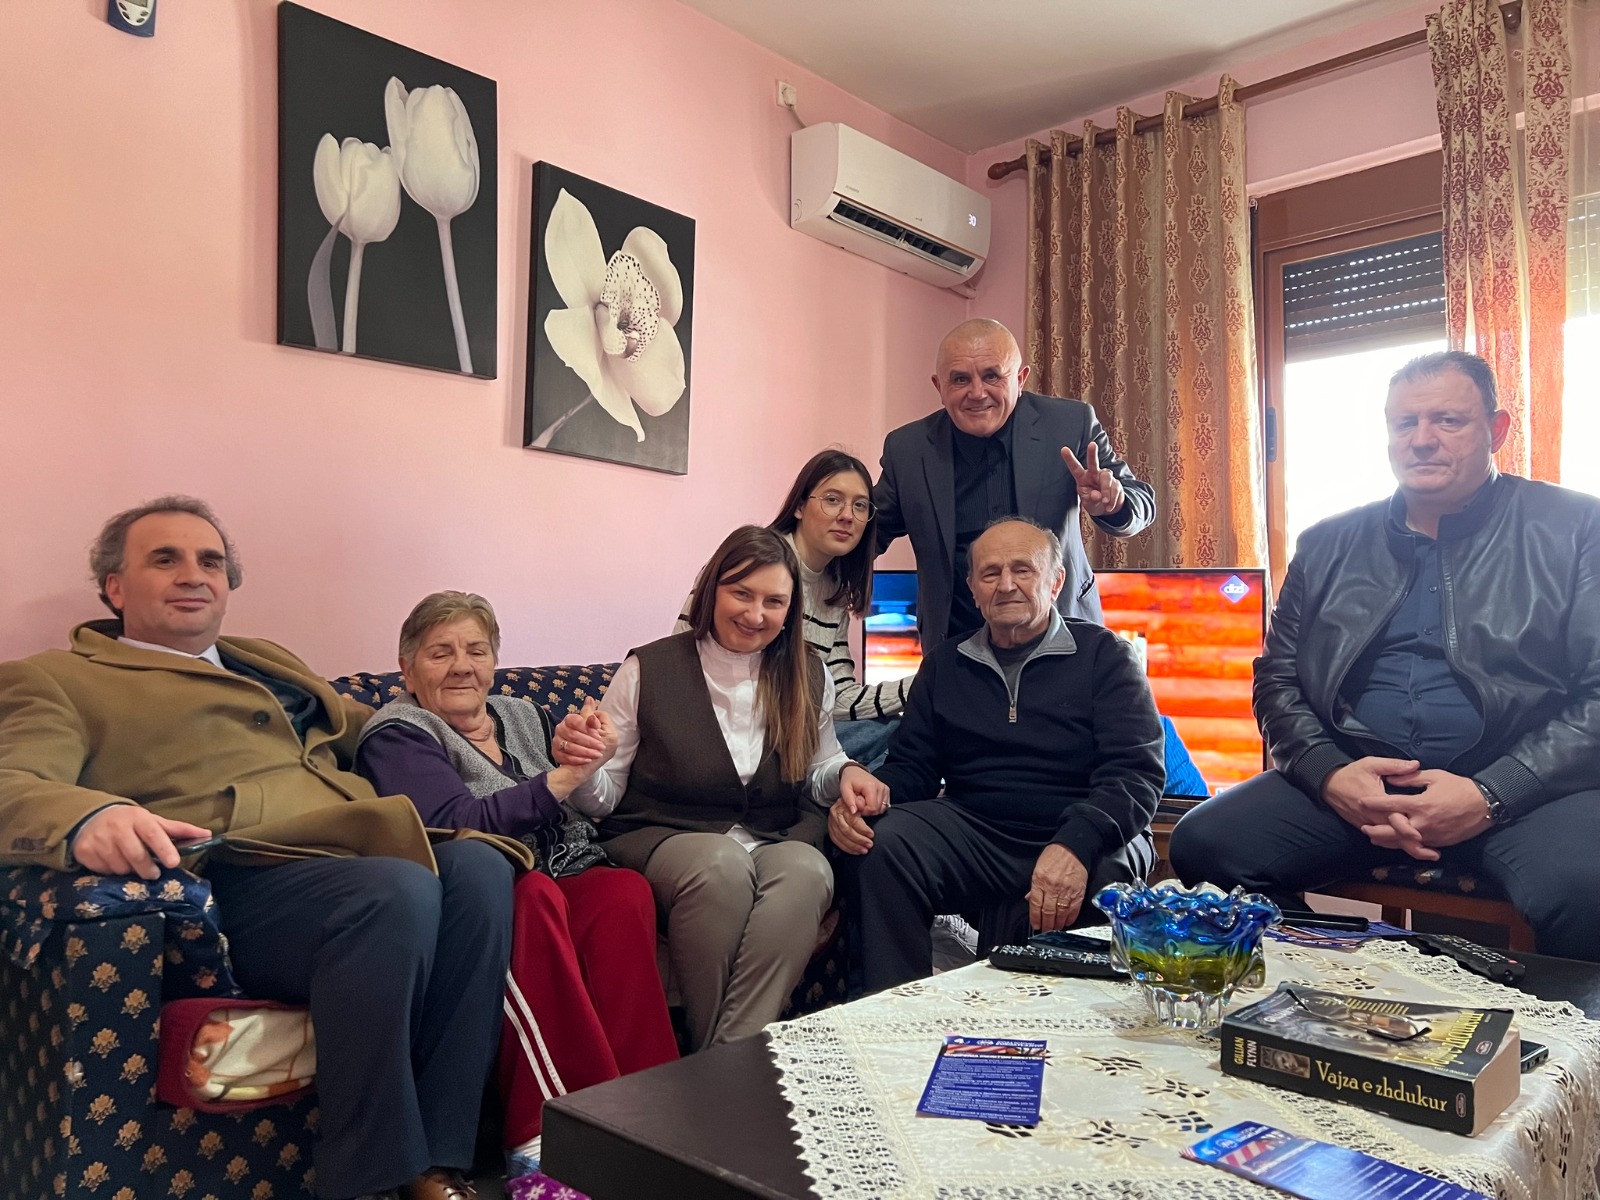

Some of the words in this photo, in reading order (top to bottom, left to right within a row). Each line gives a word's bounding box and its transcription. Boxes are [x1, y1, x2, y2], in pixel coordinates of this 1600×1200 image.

[1233, 1036, 1245, 1065] GILLIAN
[1246, 1039, 1258, 1068] FLYNN
[1315, 1060, 1360, 1090] Vajza
[1362, 1080, 1373, 1093] e
[1375, 1076, 1448, 1112] zhdukur
